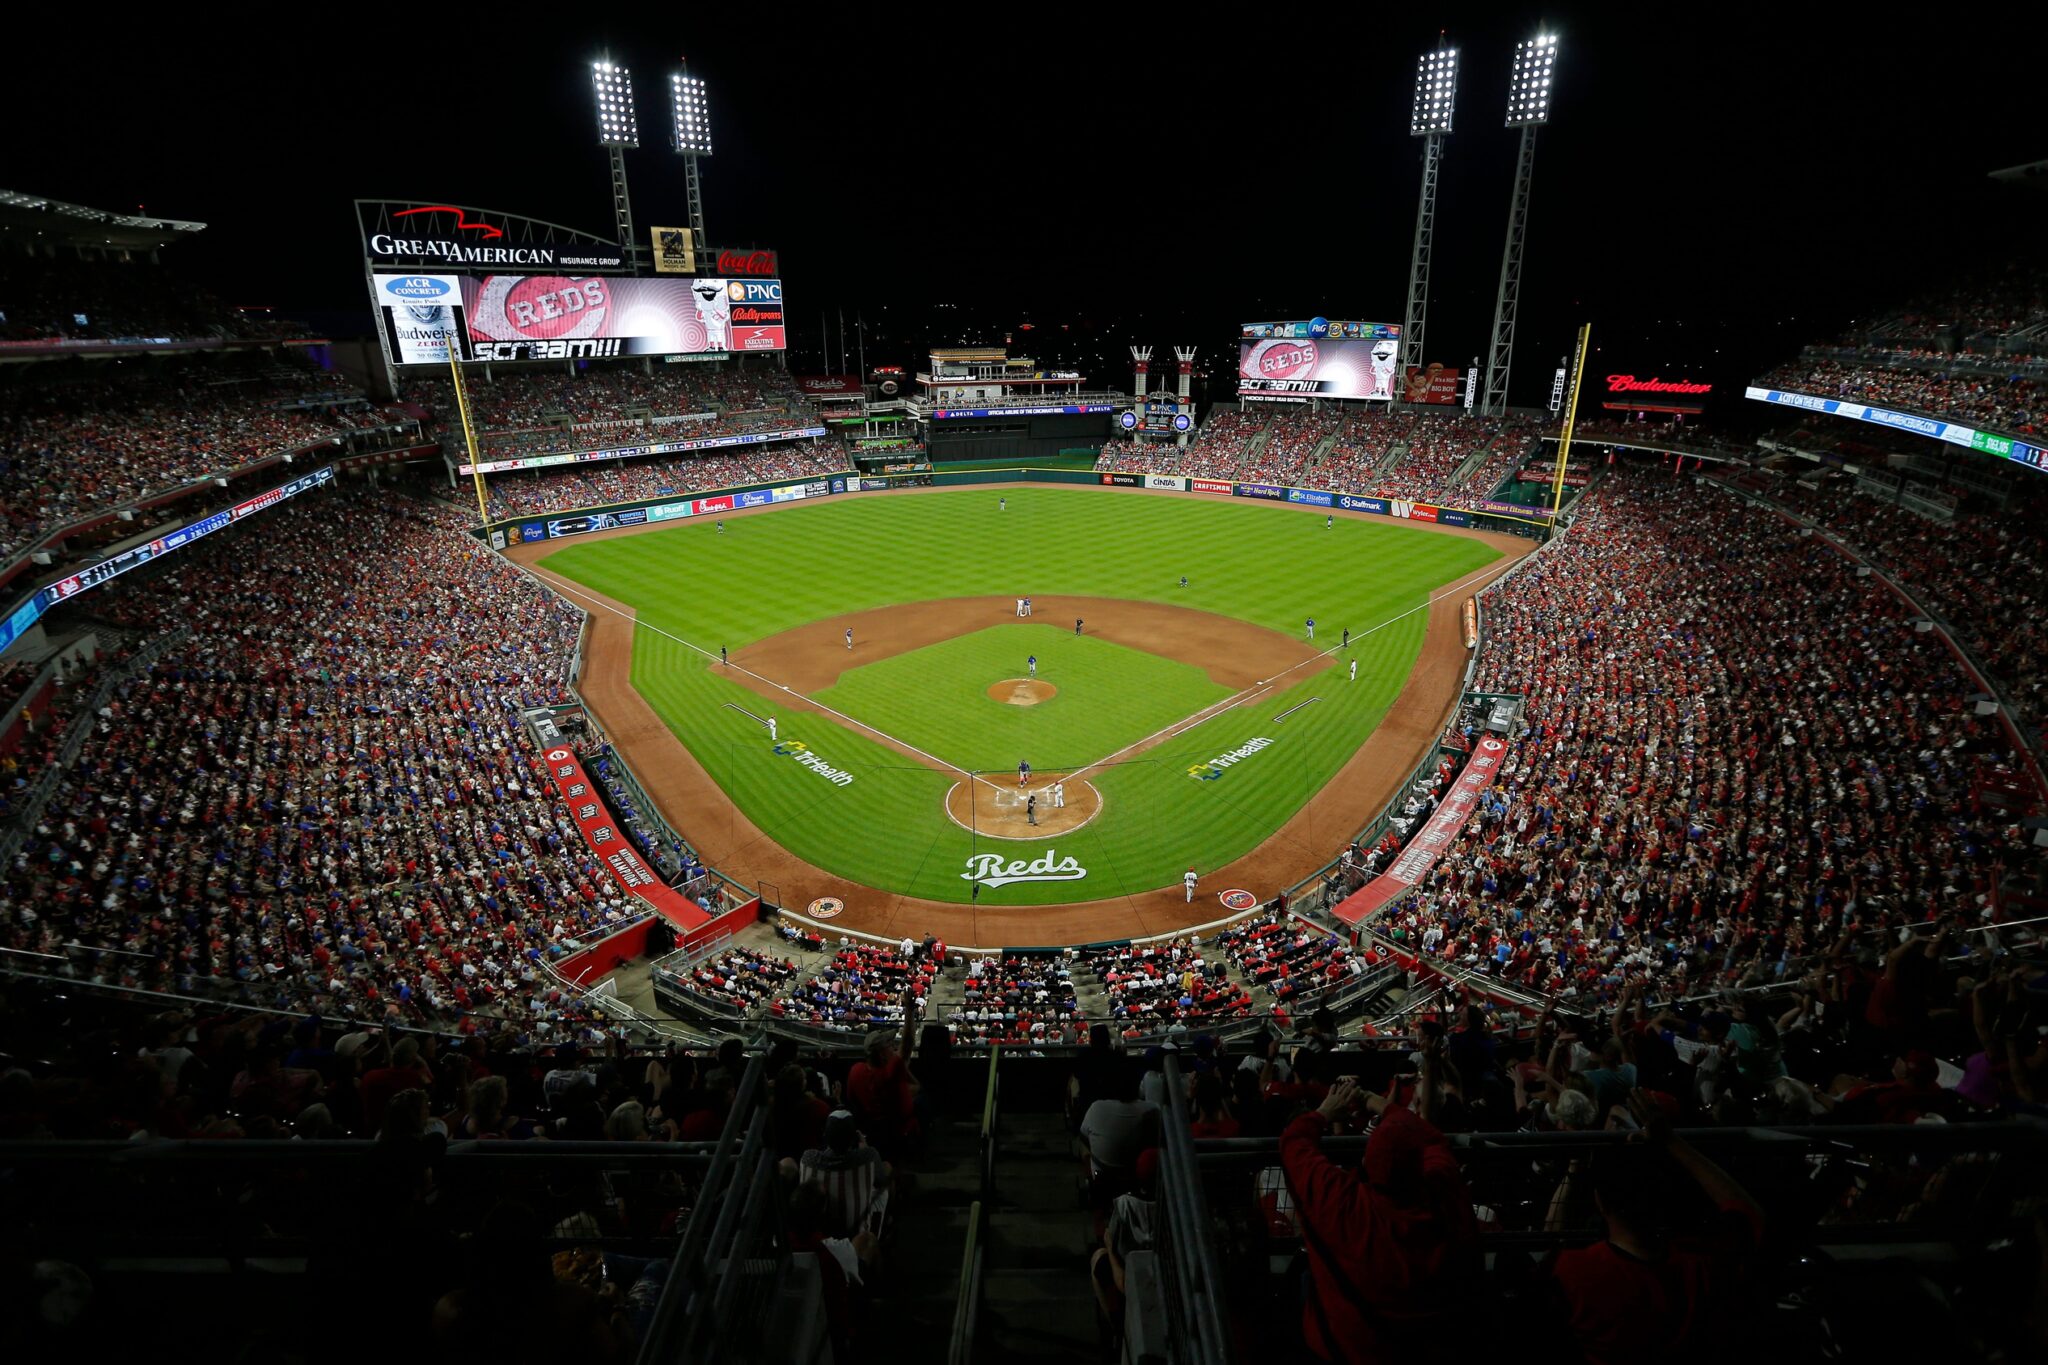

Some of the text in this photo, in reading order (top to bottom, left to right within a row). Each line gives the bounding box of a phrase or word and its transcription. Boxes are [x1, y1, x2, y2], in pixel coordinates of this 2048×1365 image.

[371, 234, 621, 267] GREAT AMERICAN INSURANCE GROUP
[405, 278, 431, 288] ACR
[395, 287, 442, 295] CONCRETE
[745, 284, 780, 300] PNC
[509, 280, 605, 328] REDS
[731, 307, 782, 323] Bally SPORTS
[1311, 324, 1327, 332] P&G
[474, 339, 621, 362] scream!!!
[1262, 347, 1315, 373] REDS
[1056, 371, 1080, 379] TriHealth
[1442, 385, 1456, 393] BOY
[1606, 374, 1712, 394] Budweiser
[1157, 404, 1173, 412] PNC
[1193, 482, 1232, 492] CRAFTSMAN
[1252, 486, 1281, 498] Hard Rock
[1306, 493, 1331, 503] Elizabeth
[1350, 499, 1382, 512] Staffmark
[664, 504, 685, 514] Ruoff
[1412, 508, 1436, 519] wyler.com
[1485, 502, 1509, 514] planet
[1509, 505, 1534, 516] fitness
[524, 527, 543, 538] Kroger
[1208, 737, 1275, 768] TriHealth
[793, 750, 854, 787] TriHealth
[594, 825, 613, 843] 1972
[607, 854, 643, 888] CHAMPIONS
[617, 848, 655, 885] NATIONAL LEAGUE
[959, 849, 1087, 889] Reds
[1401, 849, 1434, 882] CHAMPIONS
